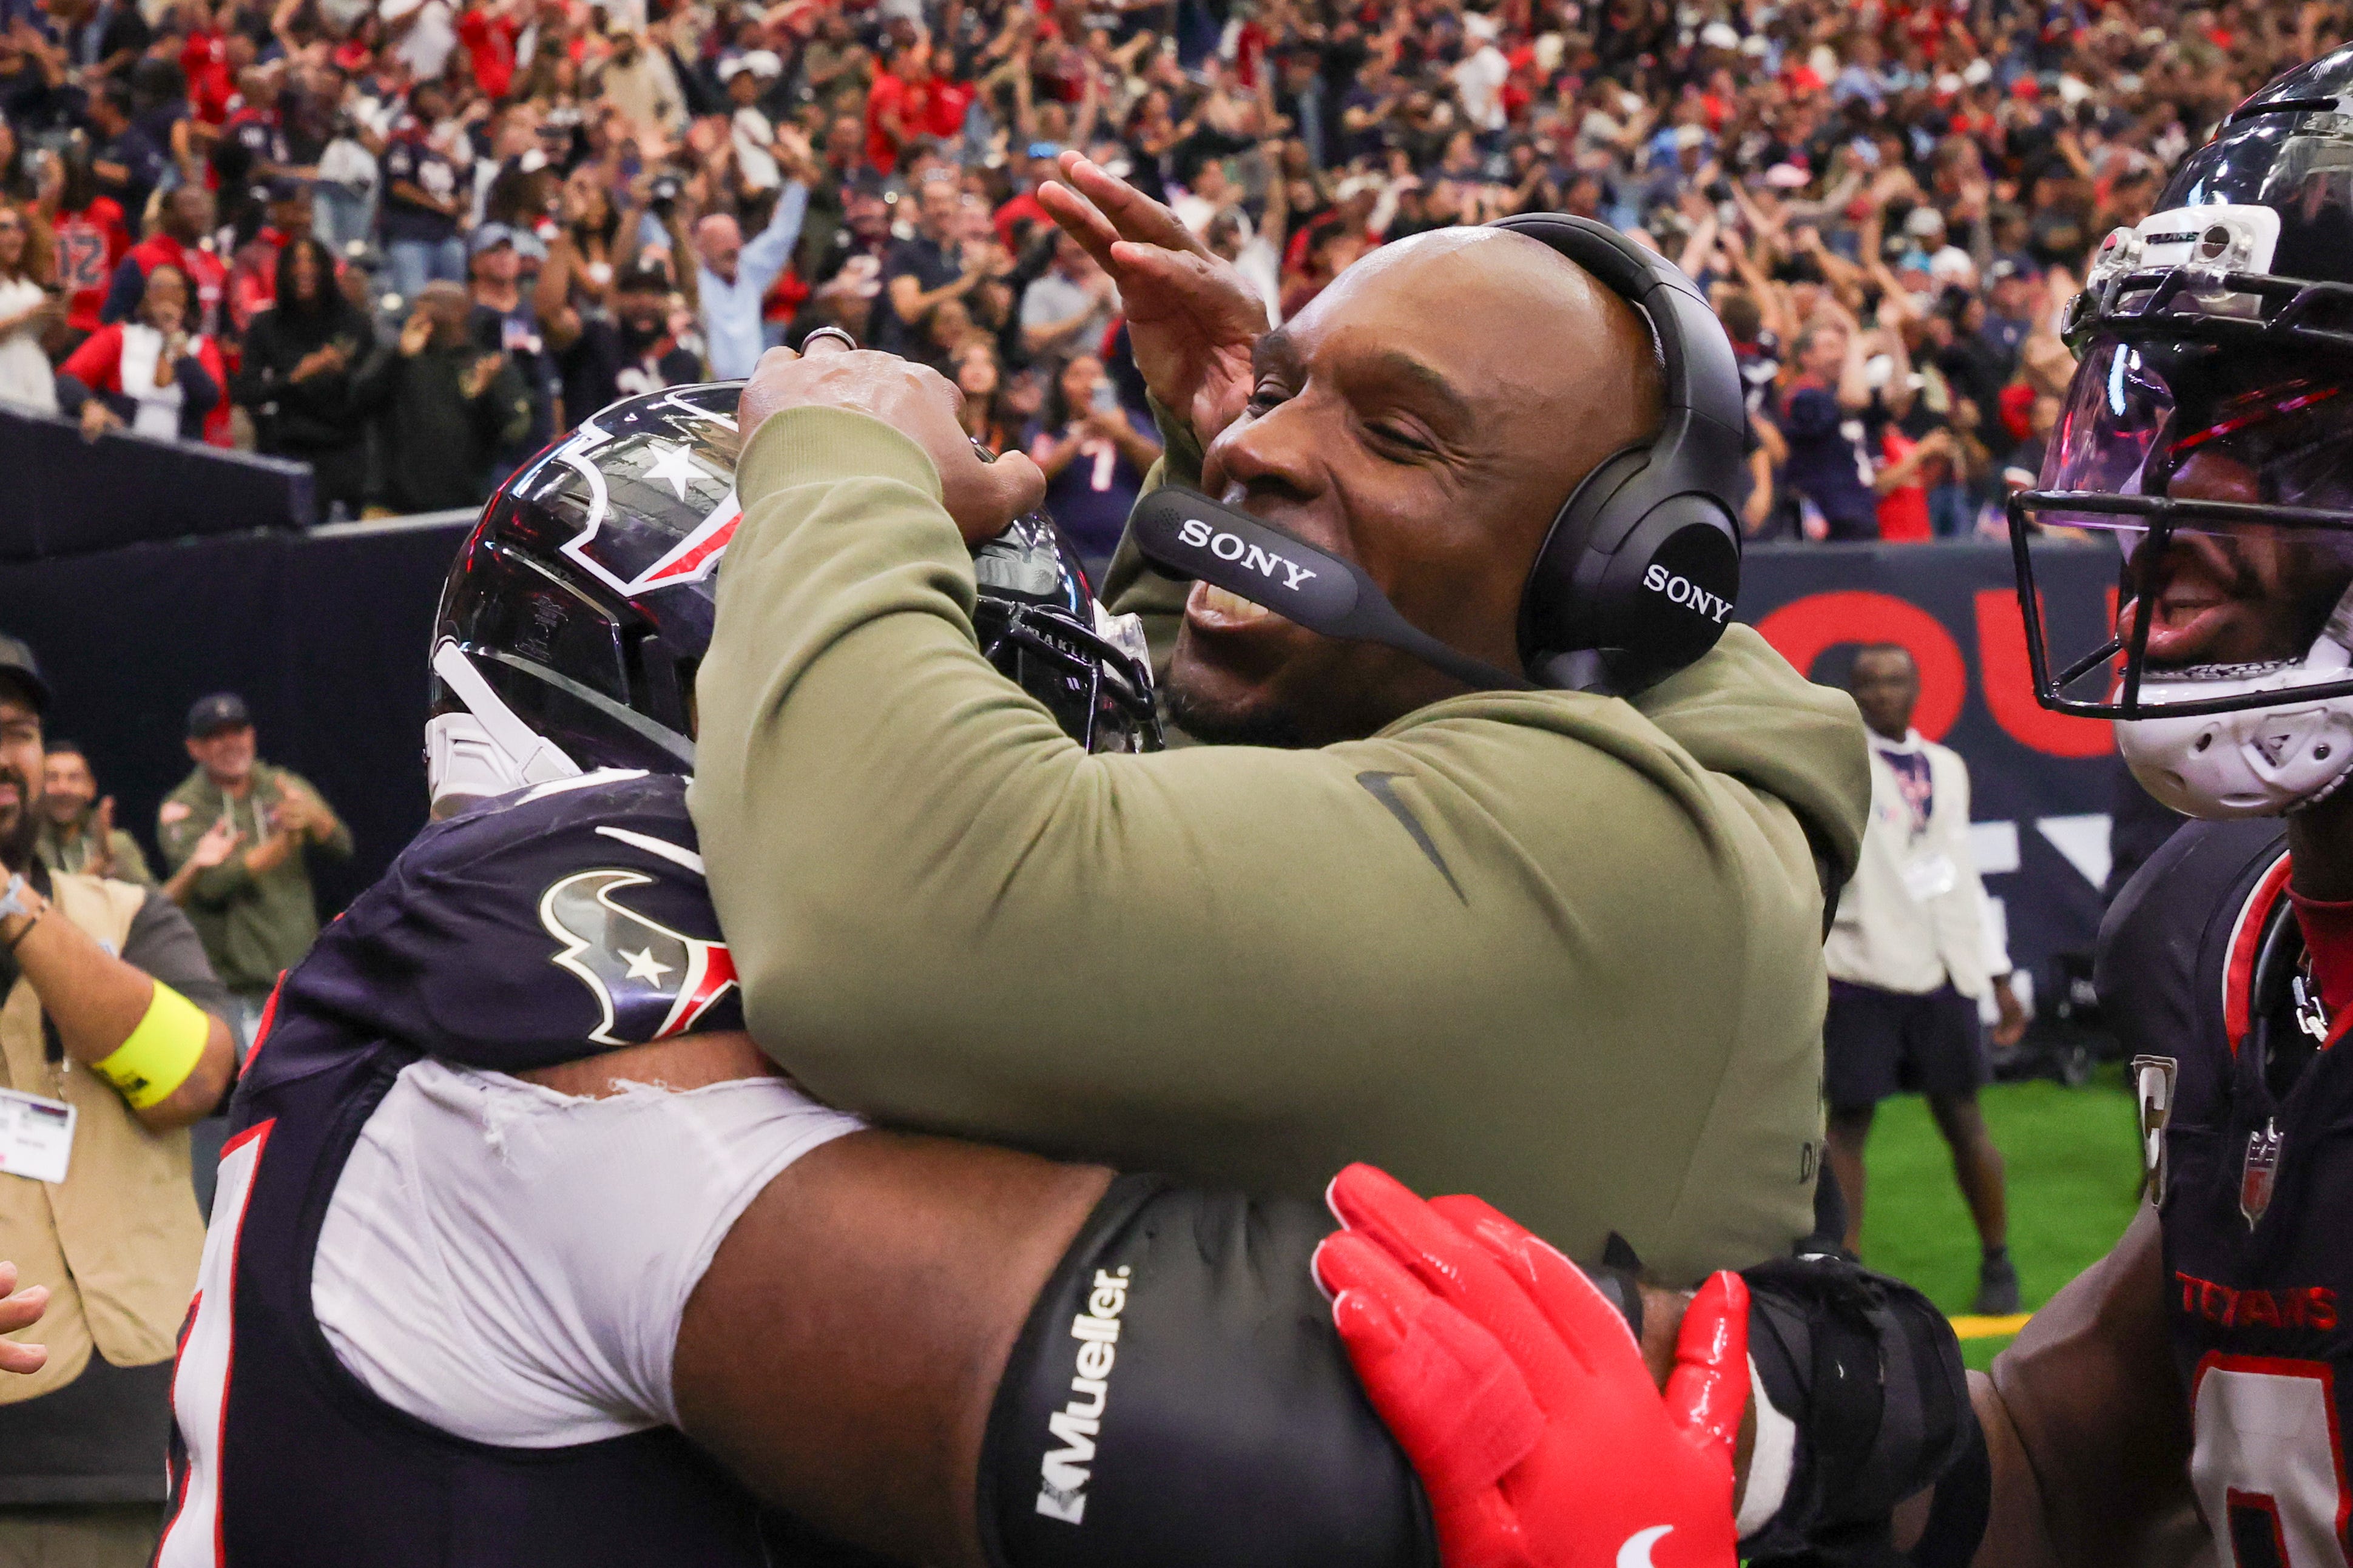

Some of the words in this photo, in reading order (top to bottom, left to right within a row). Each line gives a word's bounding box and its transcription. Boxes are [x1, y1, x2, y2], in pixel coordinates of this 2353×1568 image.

[59, 234, 102, 283] 12
[1178, 519, 1317, 591] SONY
[1643, 564, 1734, 624] SONY
